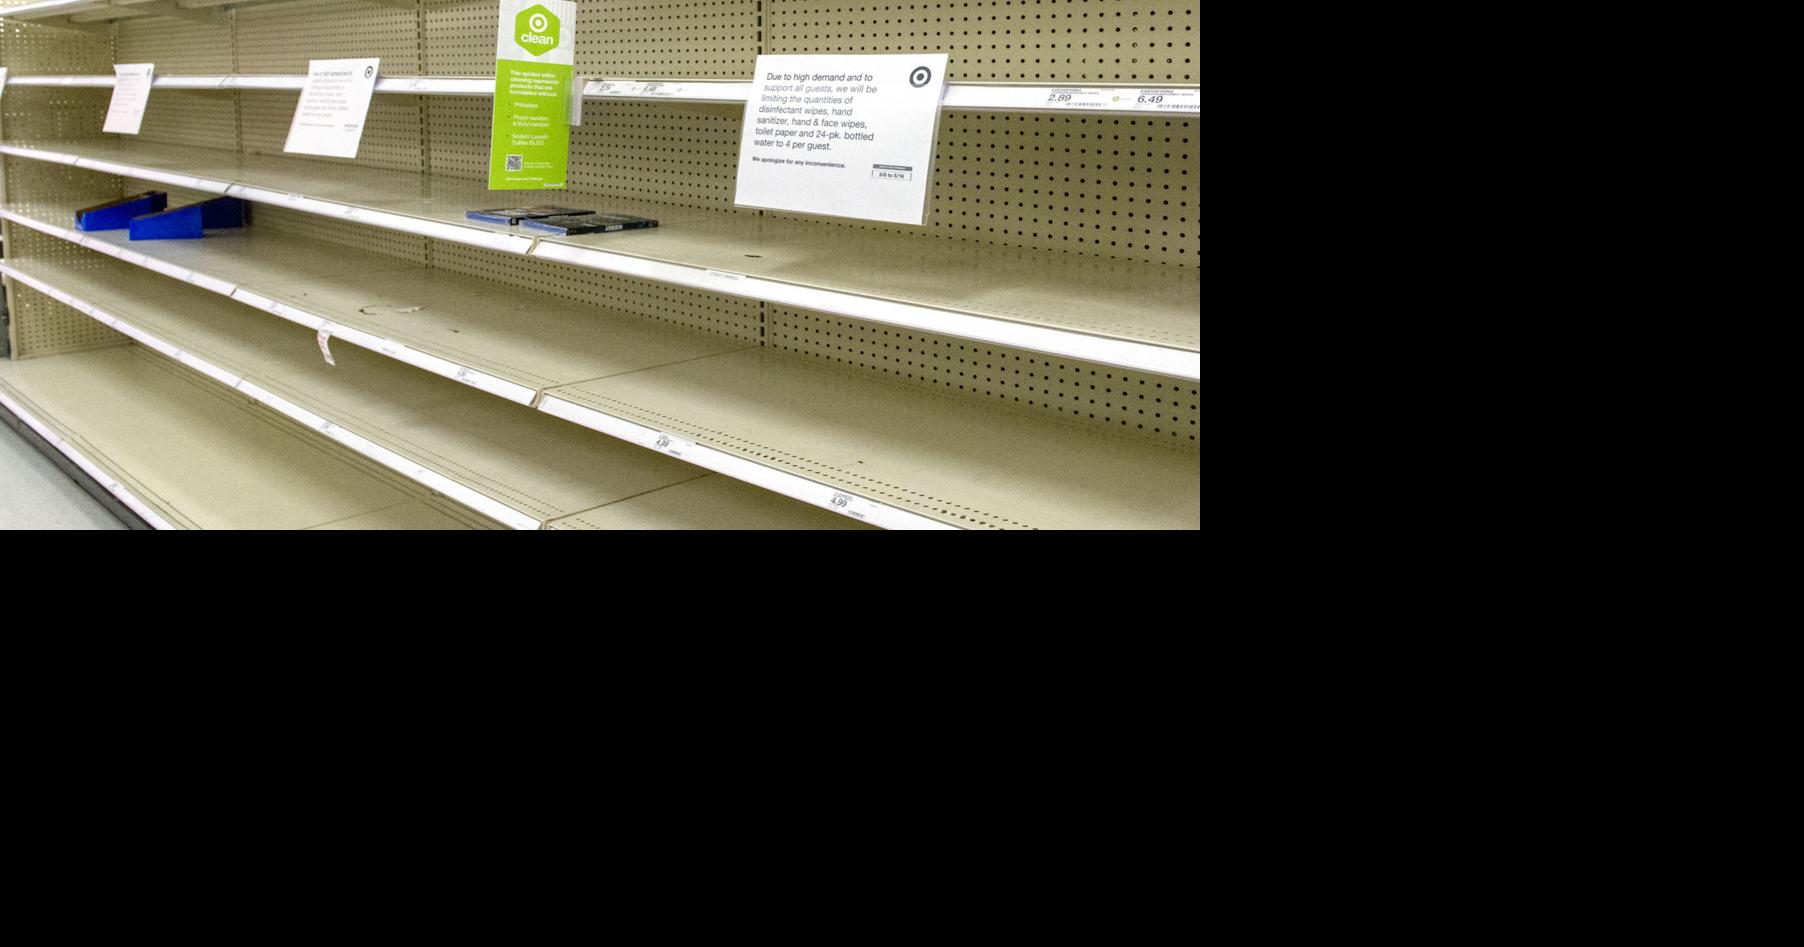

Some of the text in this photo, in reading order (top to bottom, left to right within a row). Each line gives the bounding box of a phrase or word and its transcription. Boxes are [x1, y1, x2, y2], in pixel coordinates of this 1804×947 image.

[521, 32, 554, 45] clean
[767, 72, 782, 80] Due
[793, 73, 810, 82] high
[812, 73, 845, 81] demand
[847, 73, 862, 81] and
[763, 85, 793, 93] support
[794, 84, 804, 92] all
[805, 85, 833, 93] guests,
[850, 85, 864, 93] will
[866, 85, 877, 93] be
[761, 94, 853, 104] limiting the quantities of
[1048, 94, 1072, 102] 2.89
[1137, 95, 1163, 103] 6.49
[759, 105, 853, 116] disinfectant wipes, hand
[757, 116, 868, 129] sanitizer, hand & face wipes,
[755, 127, 874, 141] toilet paper and 24-pk. bottled
[754, 139, 774, 147] water
[792, 141, 805, 149] per
[807, 142, 832, 151] guest.
[805, 160, 847, 168] inconvenience.
[830, 497, 848, 507] 4.99
